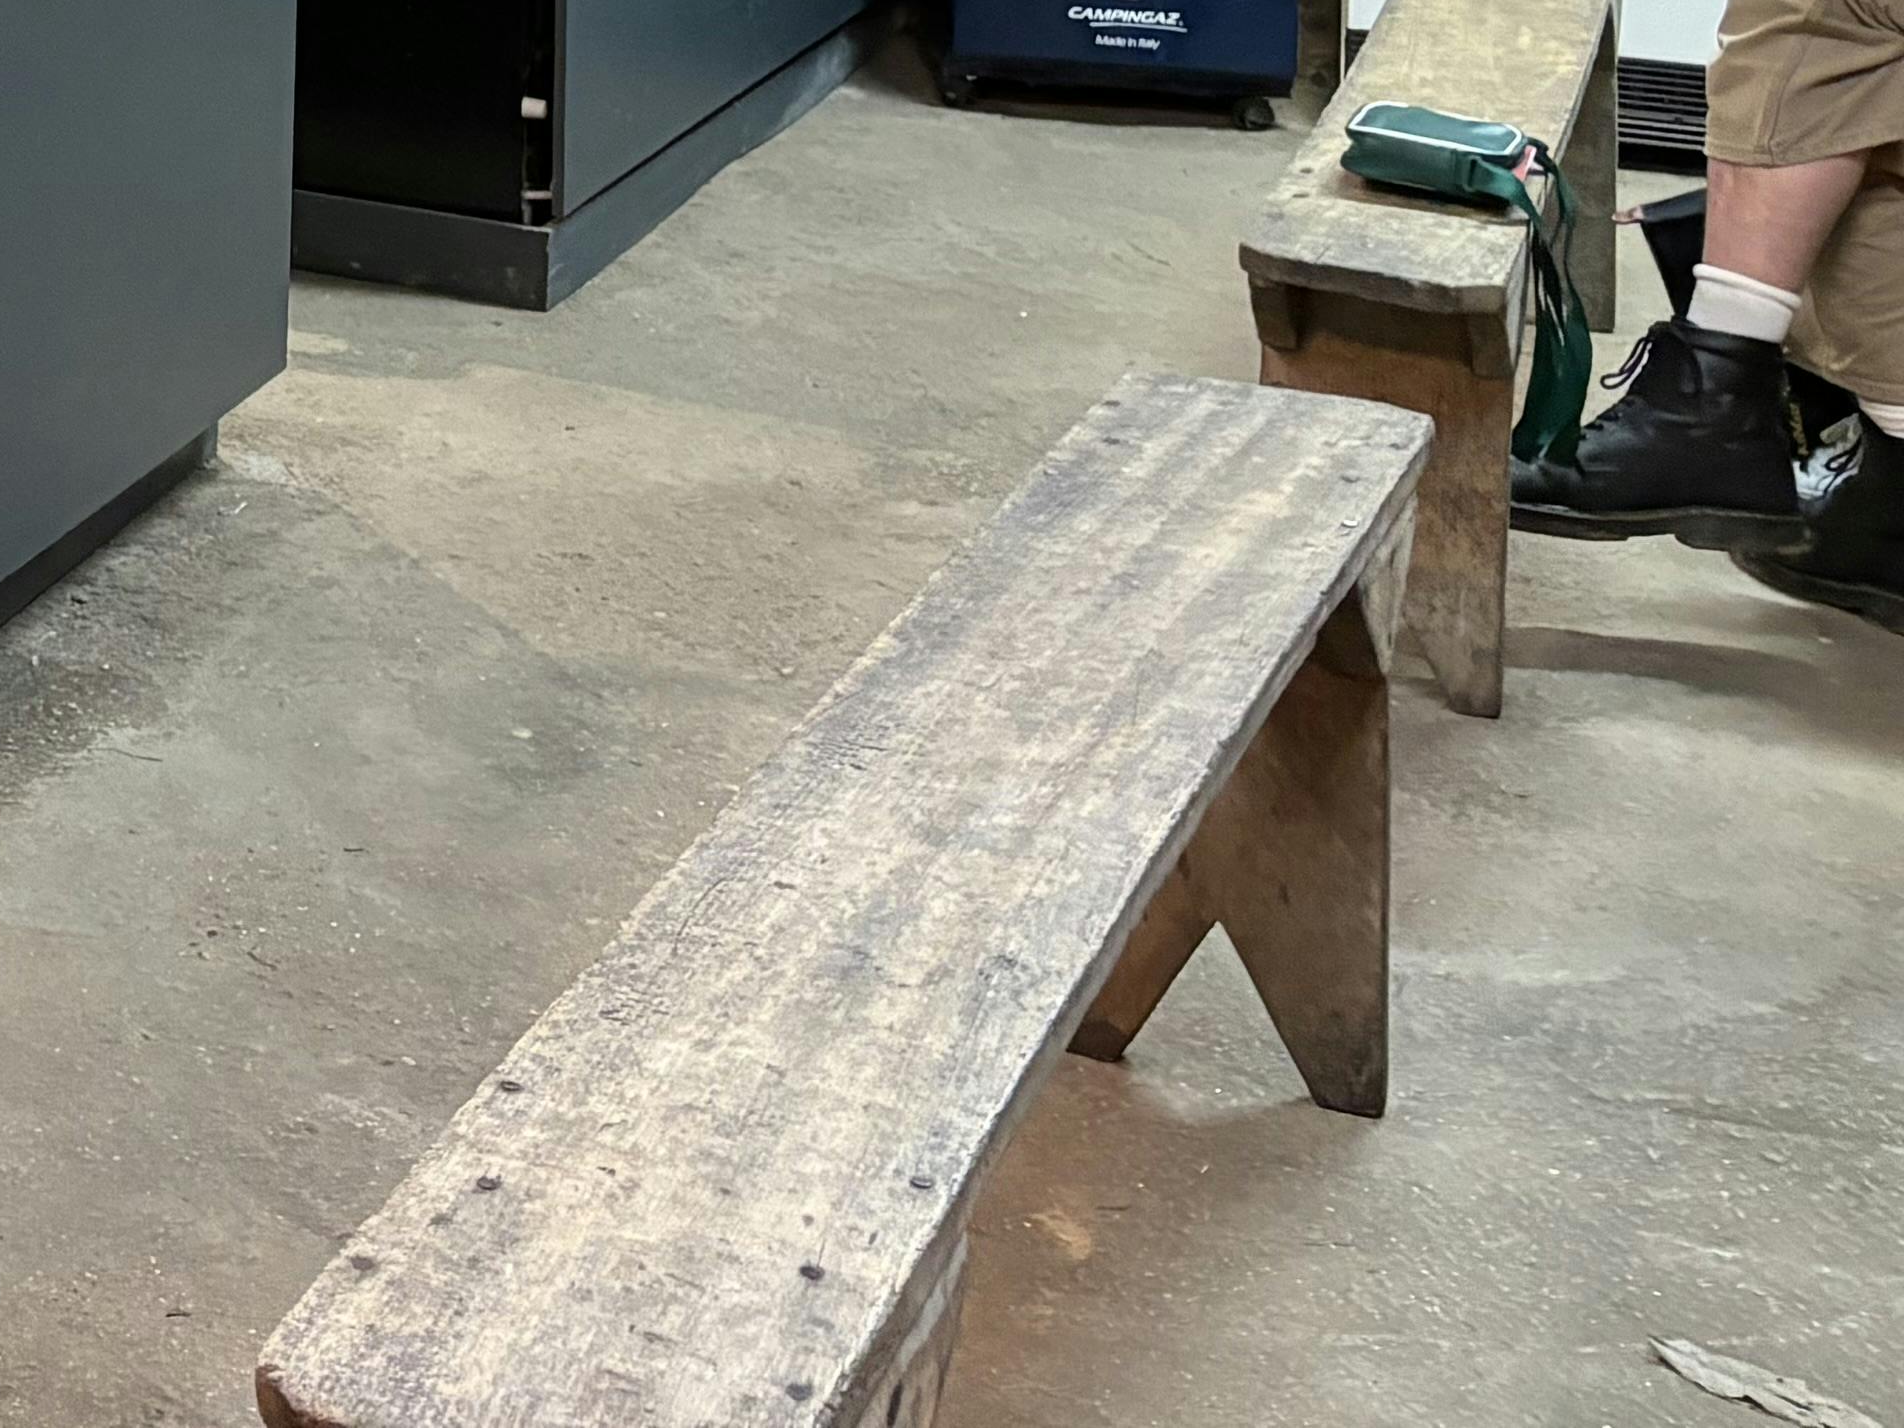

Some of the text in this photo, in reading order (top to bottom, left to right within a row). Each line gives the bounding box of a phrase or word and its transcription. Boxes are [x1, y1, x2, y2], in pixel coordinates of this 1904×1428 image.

[1067, 5, 1182, 27] CAMPINGAZ
[1094, 33, 1161, 51] Made in Italy
